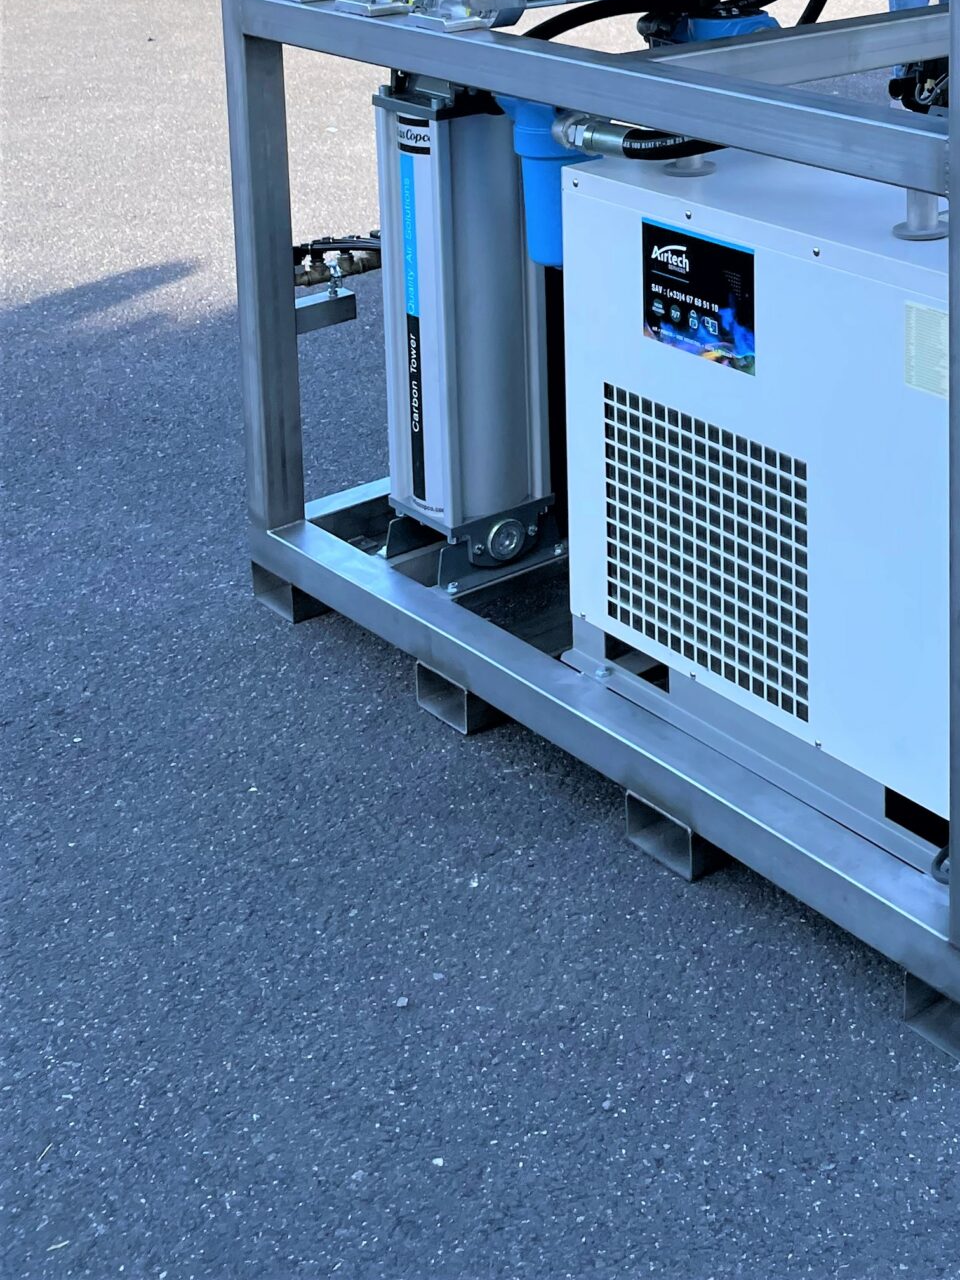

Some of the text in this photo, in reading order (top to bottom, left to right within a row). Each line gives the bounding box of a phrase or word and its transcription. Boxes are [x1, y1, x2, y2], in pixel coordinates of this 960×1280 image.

[404, 177, 412, 240] Solutions
[651, 245, 689, 272] Airtech
[407, 271, 415, 314] Quality
[651, 283, 663, 294] SAV
[686, 294, 694, 304] 67
[703, 300, 710, 310] 51
[409, 333, 419, 433] Carbon Tower
